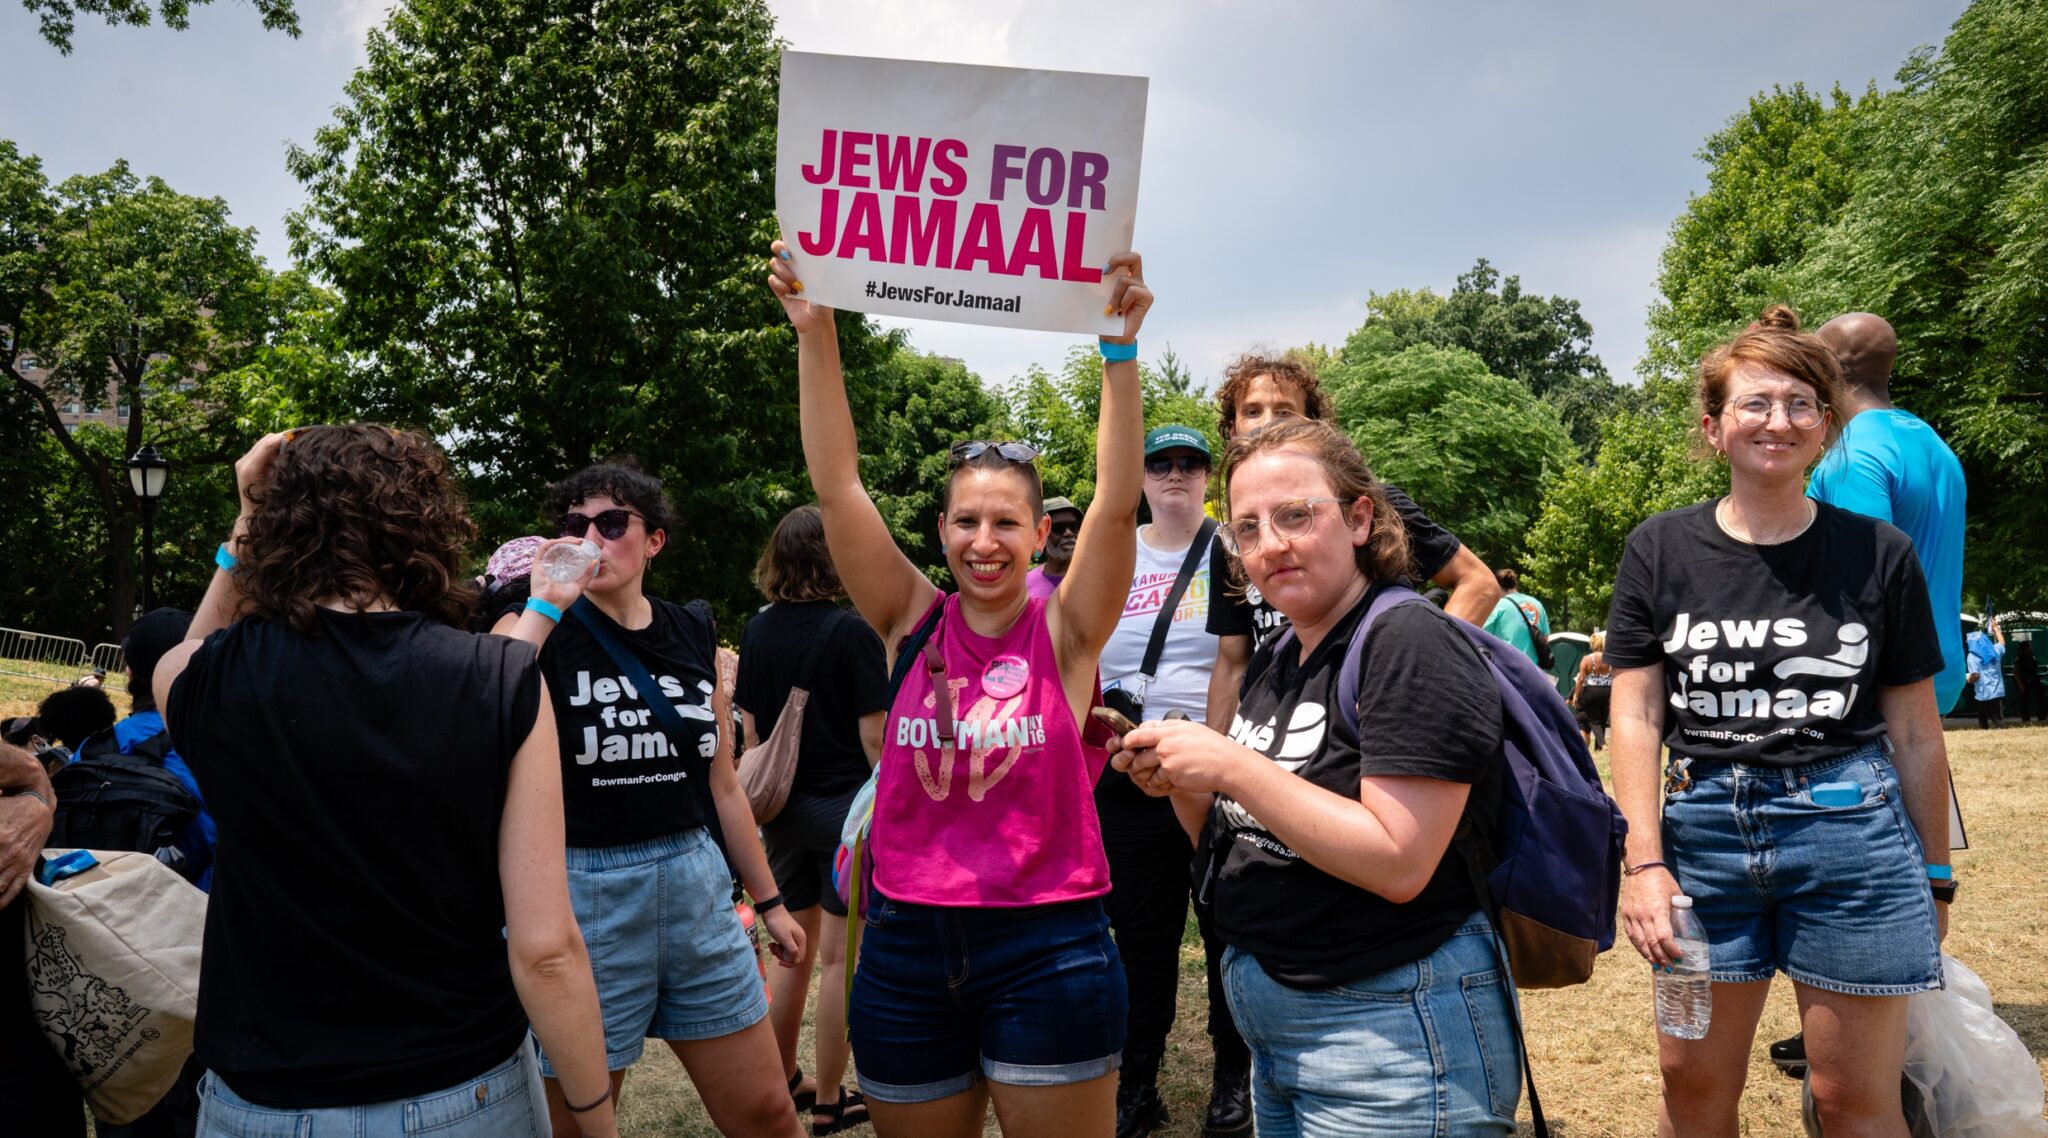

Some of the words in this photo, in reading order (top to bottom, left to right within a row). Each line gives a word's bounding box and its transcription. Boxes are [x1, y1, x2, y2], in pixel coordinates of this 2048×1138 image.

[801, 129, 968, 196] JEWS
[989, 144, 1109, 211] FOR
[797, 189, 1103, 283] JAMAAL
[865, 280, 1021, 313] #JewsForJamaal
[1254, 608, 1286, 629] for
[1663, 613, 1808, 653] Jews
[1689, 655, 1755, 683] for
[600, 706, 651, 729] for
[575, 725, 720, 766] Jama
[1029, 728, 1046, 745] 16
